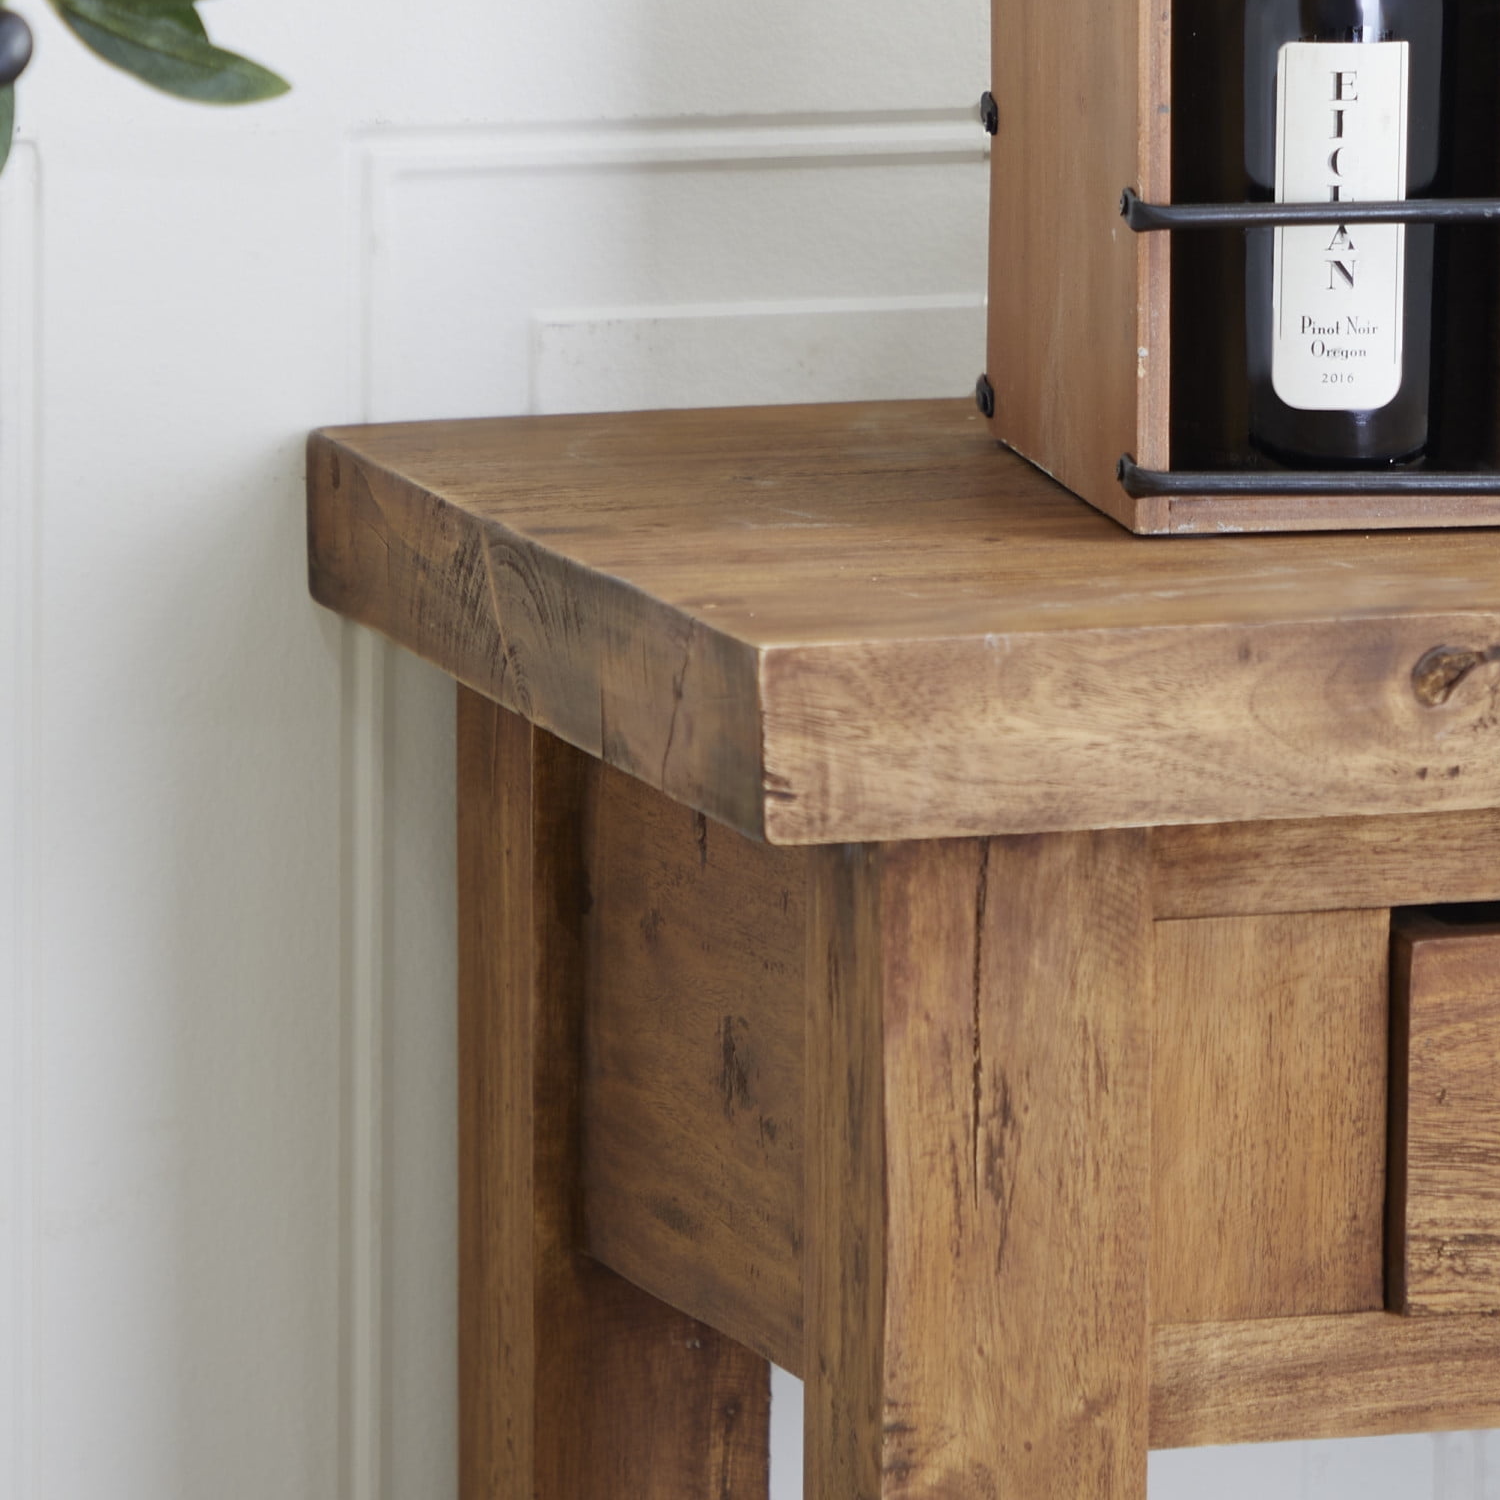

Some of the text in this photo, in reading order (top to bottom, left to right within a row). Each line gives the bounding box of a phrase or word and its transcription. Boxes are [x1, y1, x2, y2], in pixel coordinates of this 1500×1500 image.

[1301, 315, 1379, 335] Pinot Noir
[1310, 339, 1367, 361] Oregon
[1322, 372, 1354, 384] 2016
